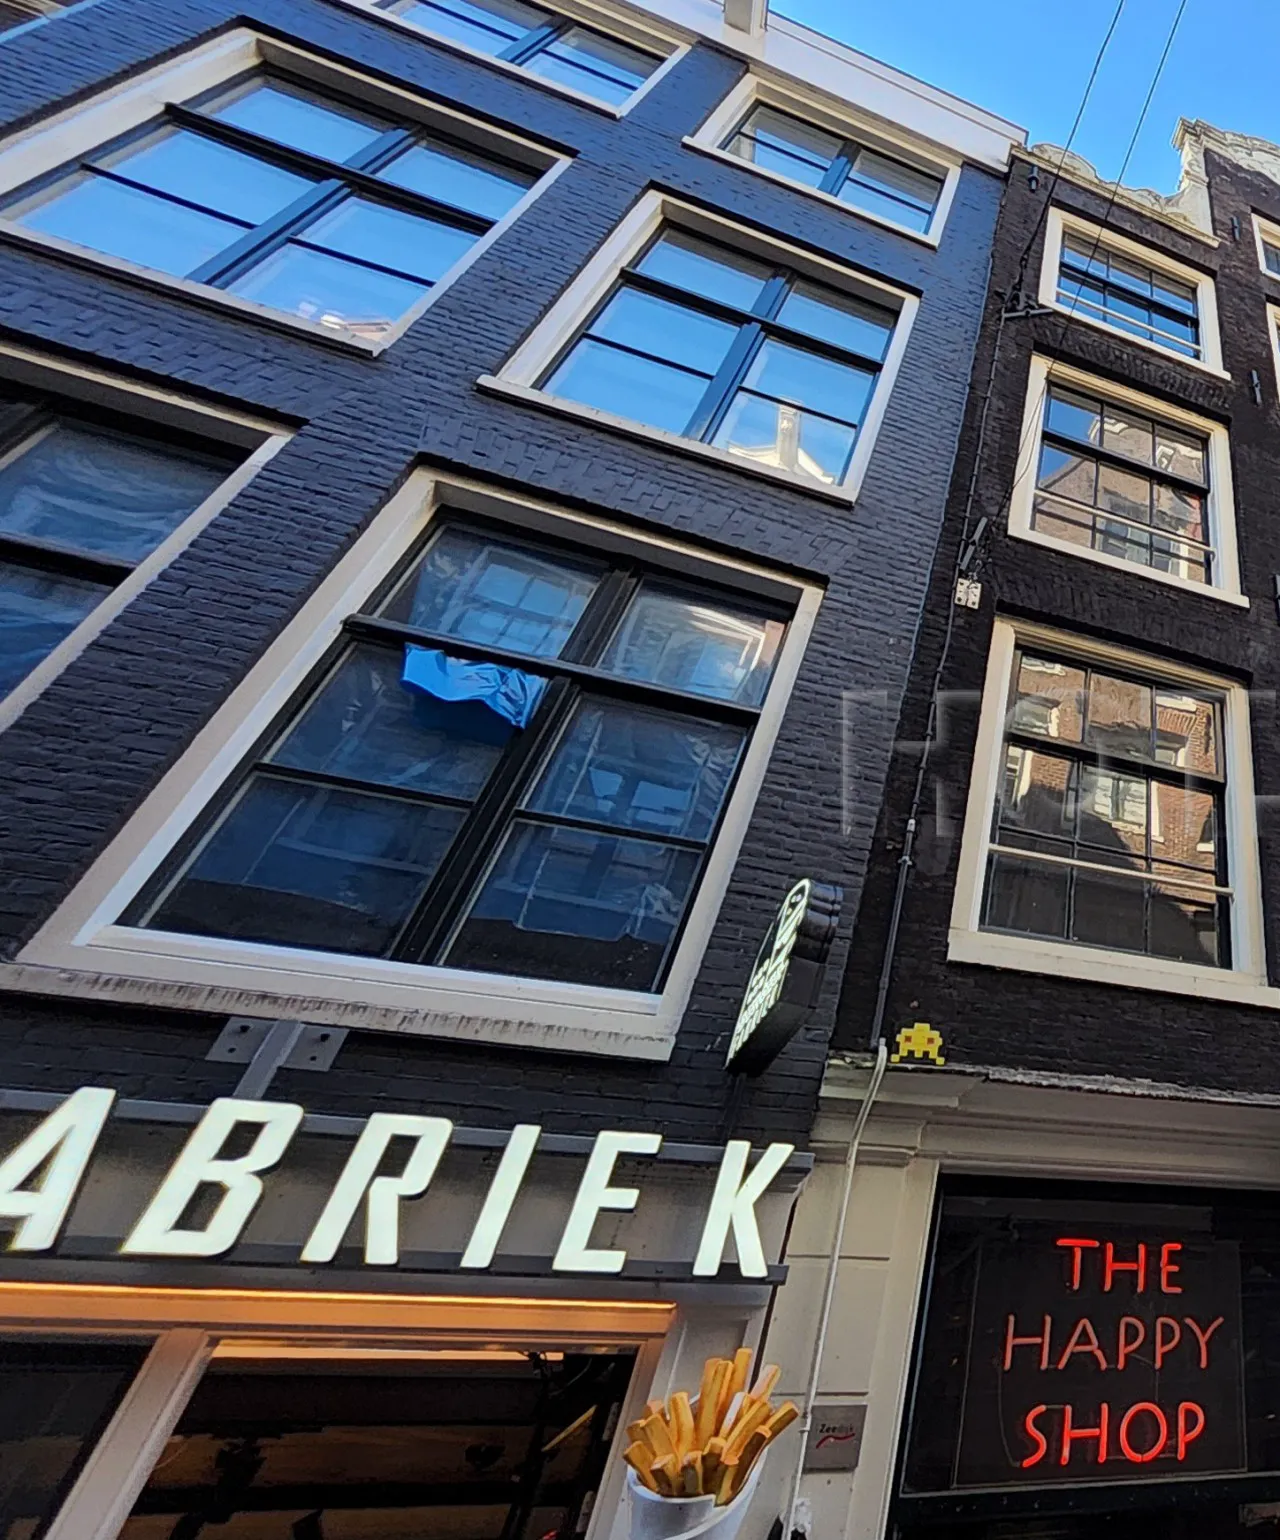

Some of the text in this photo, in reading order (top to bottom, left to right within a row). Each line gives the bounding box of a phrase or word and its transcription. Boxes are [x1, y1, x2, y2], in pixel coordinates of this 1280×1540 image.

[1054, 1237, 1184, 1295] THE
[1002, 1313, 1225, 1371] HAPPY
[1020, 1400, 1208, 1469] SHOP
